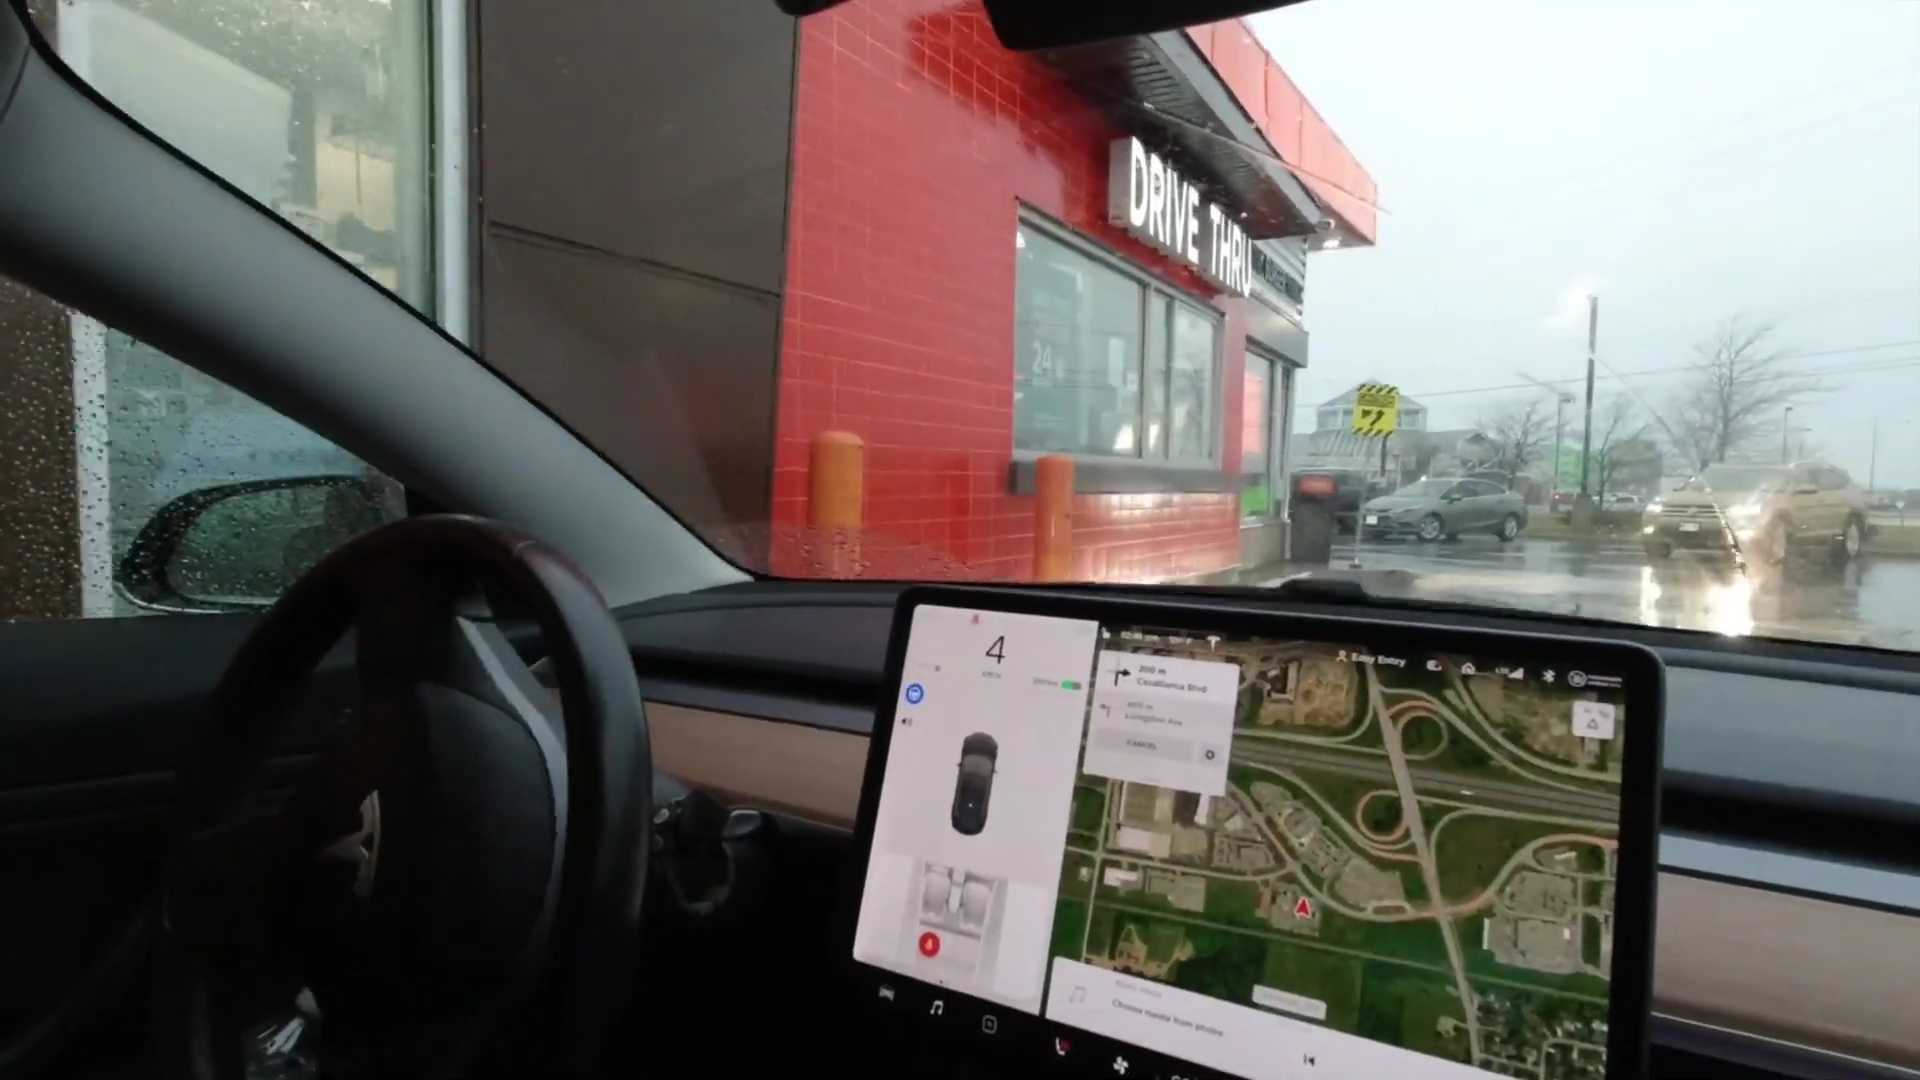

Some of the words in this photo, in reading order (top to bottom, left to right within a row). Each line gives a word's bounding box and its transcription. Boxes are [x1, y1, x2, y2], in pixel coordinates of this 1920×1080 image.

[1130, 136, 1200, 265] DRIVE
[1210, 202, 1251, 298] THRU
[985, 635, 1006, 665] 4
[1377, 655, 1407, 668] Entry
